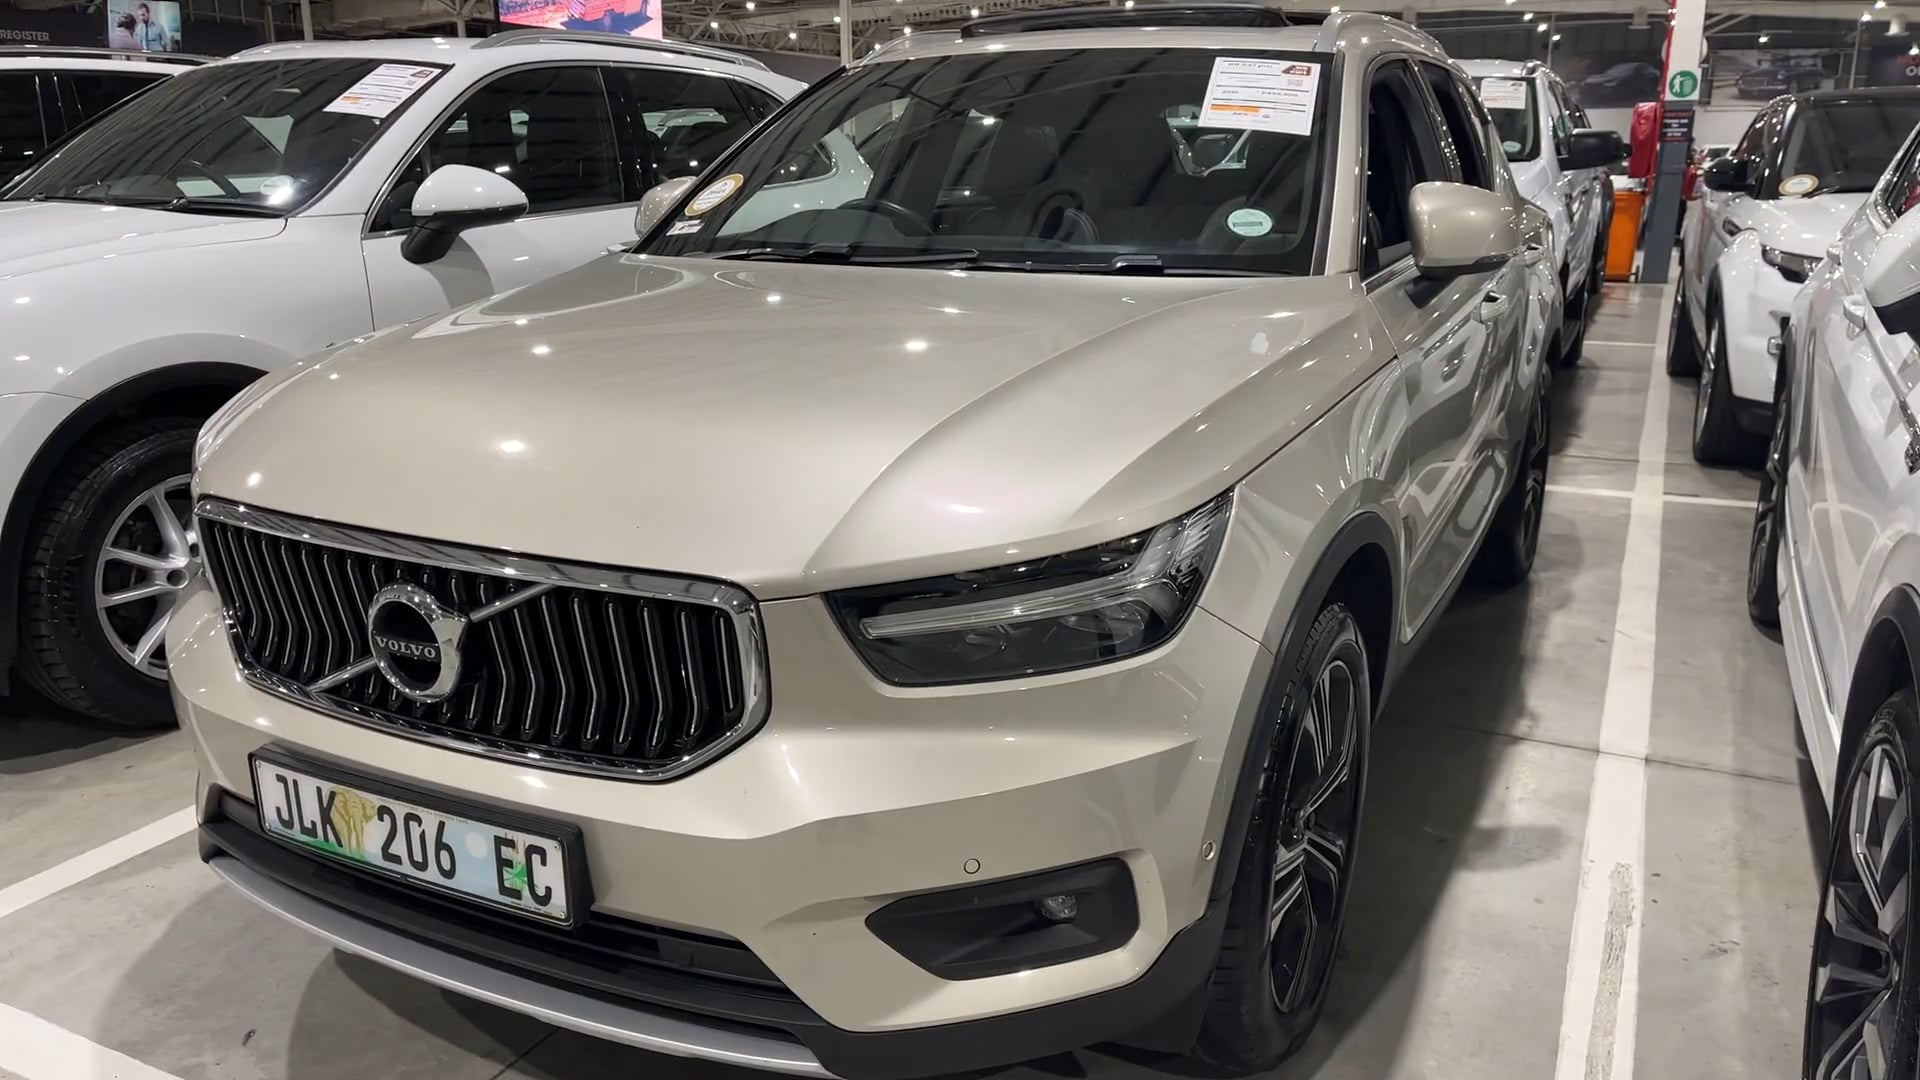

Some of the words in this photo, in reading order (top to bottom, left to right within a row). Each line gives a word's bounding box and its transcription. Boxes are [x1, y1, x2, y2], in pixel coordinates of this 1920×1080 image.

[0, 30, 49, 41] REGISTER
[374, 636, 436, 658] VOLVO
[274, 773, 345, 848] JLK
[376, 804, 456, 880] 206
[493, 834, 553, 906] EC
